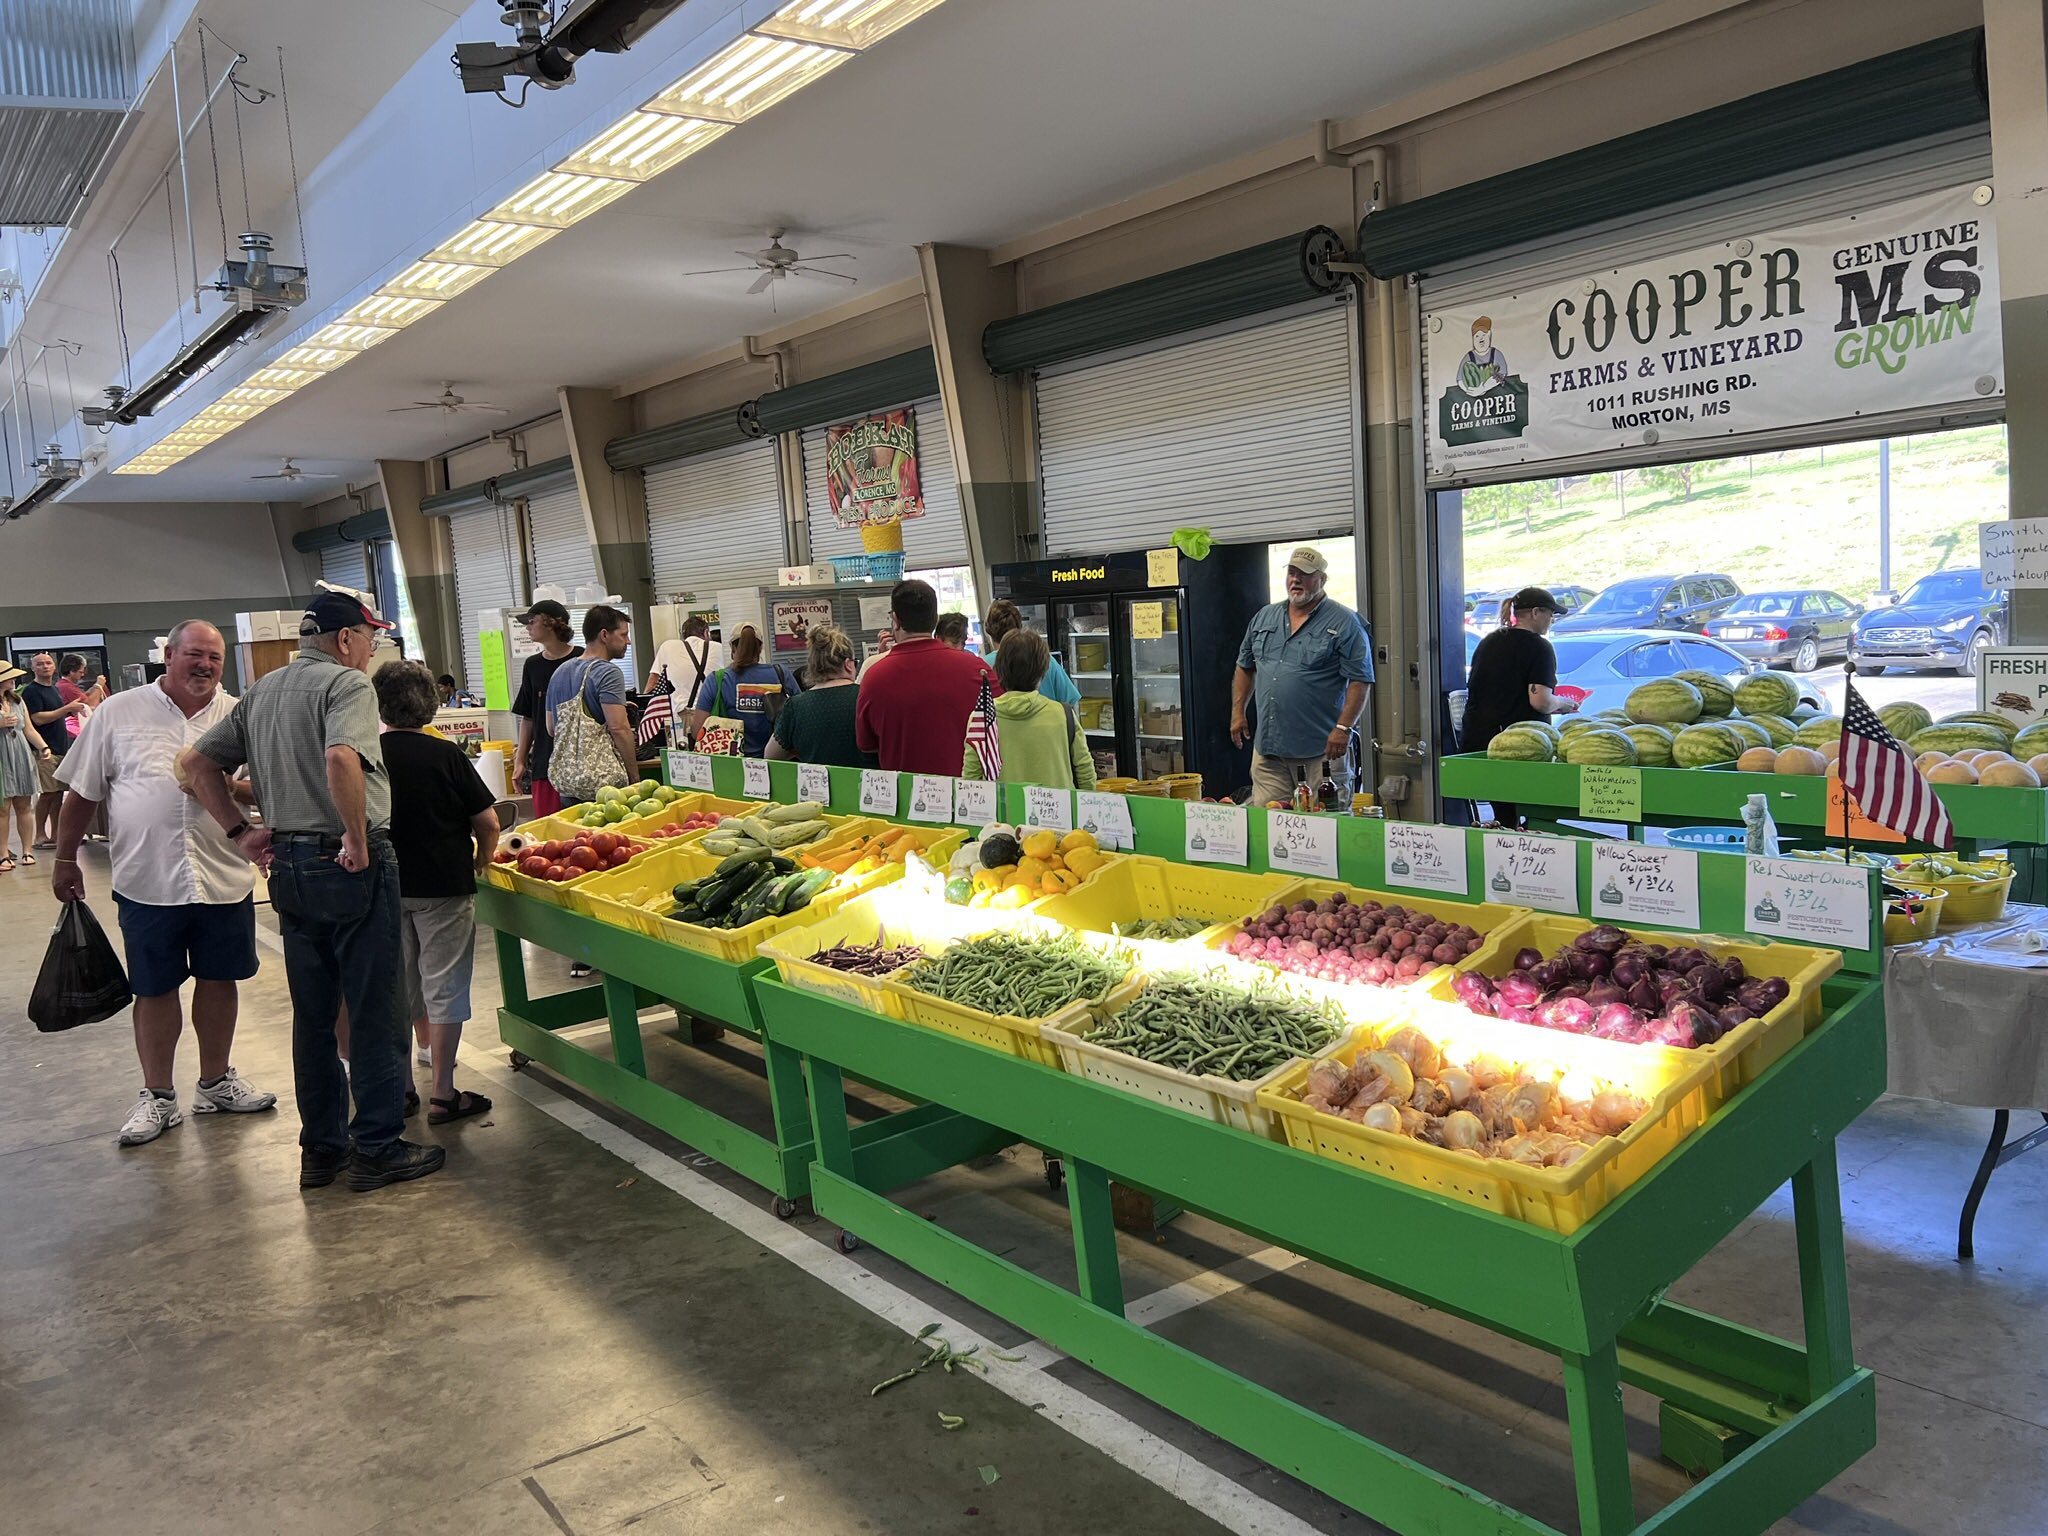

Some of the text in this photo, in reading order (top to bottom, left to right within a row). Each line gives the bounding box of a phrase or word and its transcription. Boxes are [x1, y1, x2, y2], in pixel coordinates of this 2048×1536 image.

[1833, 220, 1979, 270] GENUINE
[1834, 246, 1981, 332] MS
[1546, 248, 1805, 360] COOPER
[1834, 295, 1978, 375] GROWN
[1550, 328, 1804, 394] FARMS & VINEYARD
[1587, 374, 1757, 413] 1011 RUSHING RD.
[1451, 393, 1516, 421] COOPER
[1612, 400, 1731, 430] MORTON, MS
[1451, 421, 1473, 431] FARMS
[1482, 415, 1516, 426] VINEYARD
[856, 453, 891, 487] Farms
[885, 482, 897, 495] MS
[868, 496, 917, 520] PRODUCE
[1986, 524, 2044, 541] Smith
[1052, 566, 1105, 582] Fresh Food
[777, 605, 829, 617] CHICKEN COOP
[1990, 659, 2047, 674] FRESH
[454, 722, 478, 730] EGGS
[698, 730, 732, 751] ADER
[703, 740, 729, 754] OE'S
[1276, 814, 1307, 830] OKRA
[1496, 837, 1556, 855] New Potatoes
[1596, 846, 1625, 860] Yellow
[1749, 860, 1773, 876] Red
[1776, 864, 1820, 883] Sweet
